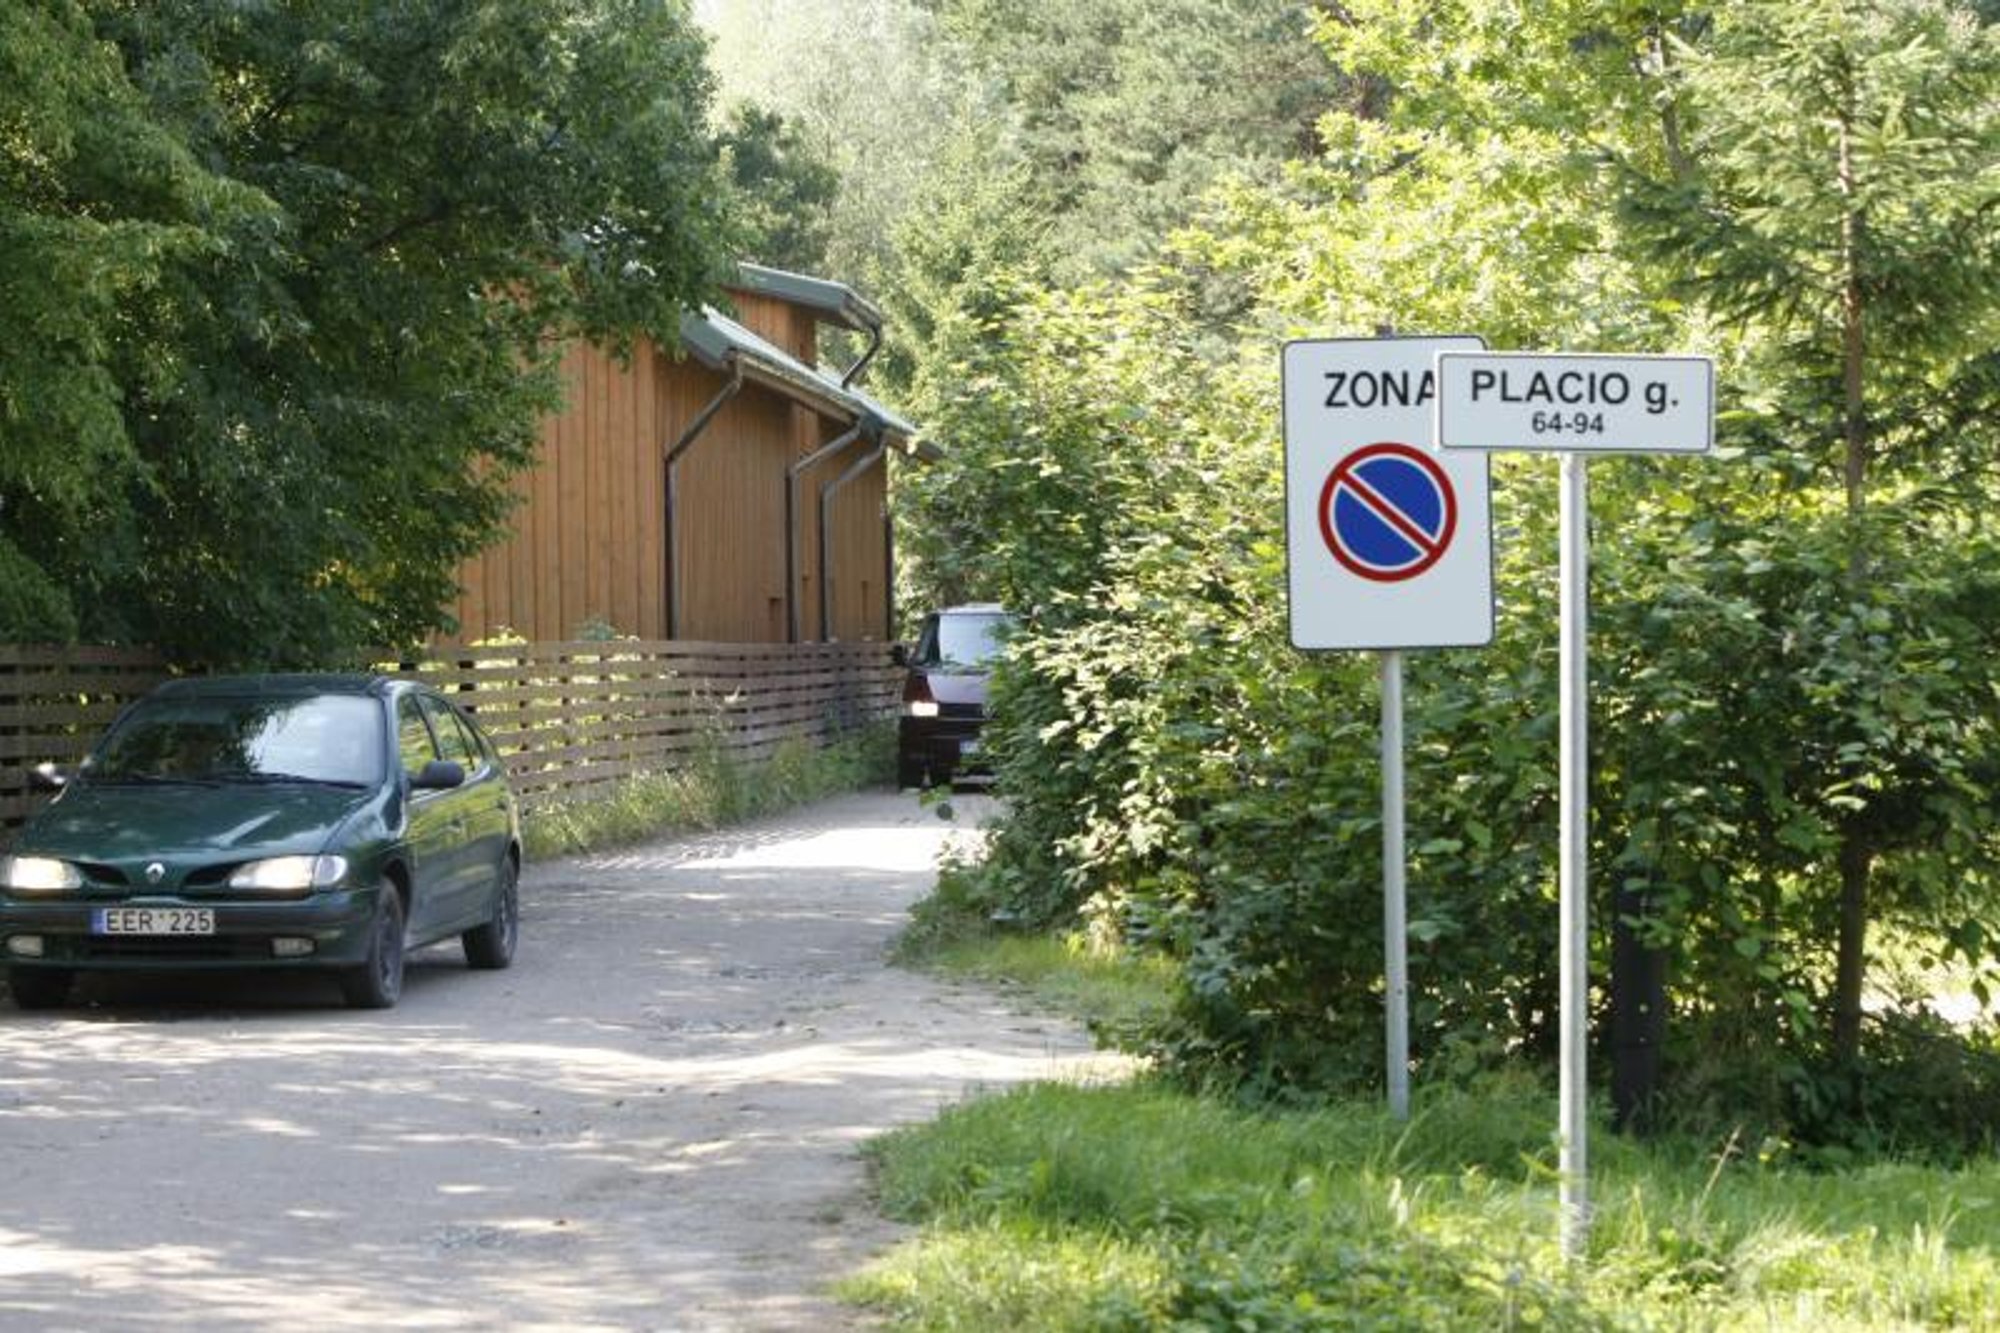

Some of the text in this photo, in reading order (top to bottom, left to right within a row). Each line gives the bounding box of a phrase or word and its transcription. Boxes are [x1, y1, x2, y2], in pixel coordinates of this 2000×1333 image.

[1472, 370, 1678, 414] PLACIO g.
[1532, 411, 1604, 434] 64-94
[106, 909, 210, 932] EER 225
